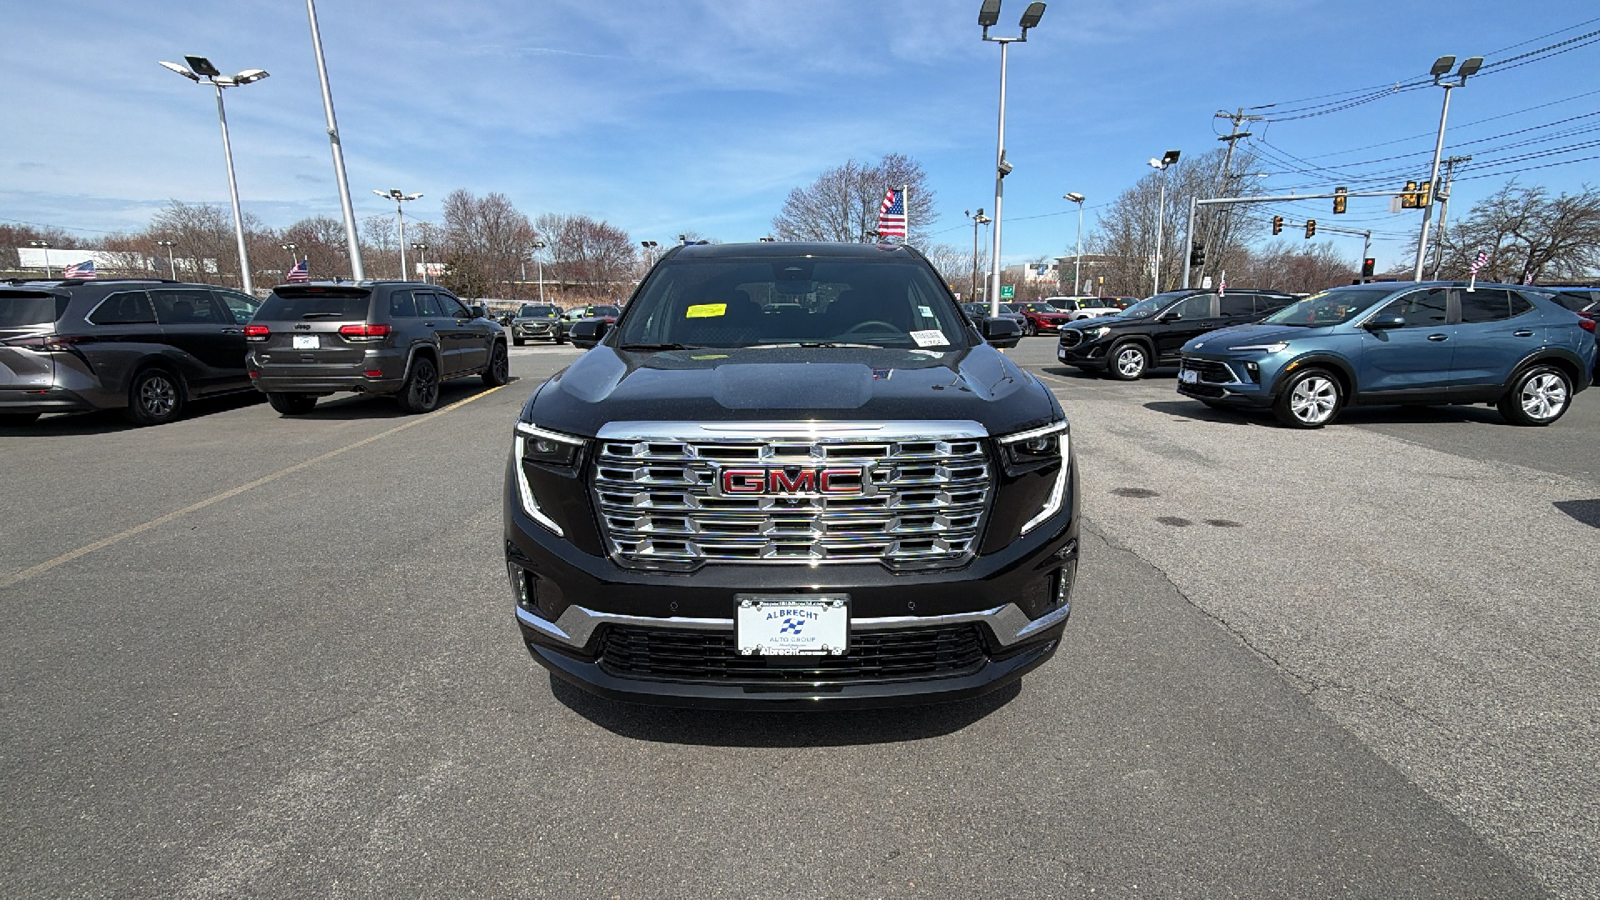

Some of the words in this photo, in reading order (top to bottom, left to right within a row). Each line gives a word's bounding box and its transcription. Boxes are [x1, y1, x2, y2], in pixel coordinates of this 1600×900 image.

[724, 469, 862, 493] GMC
[766, 609, 819, 620] ALBRECHT
[760, 647, 800, 655] Albrecht
